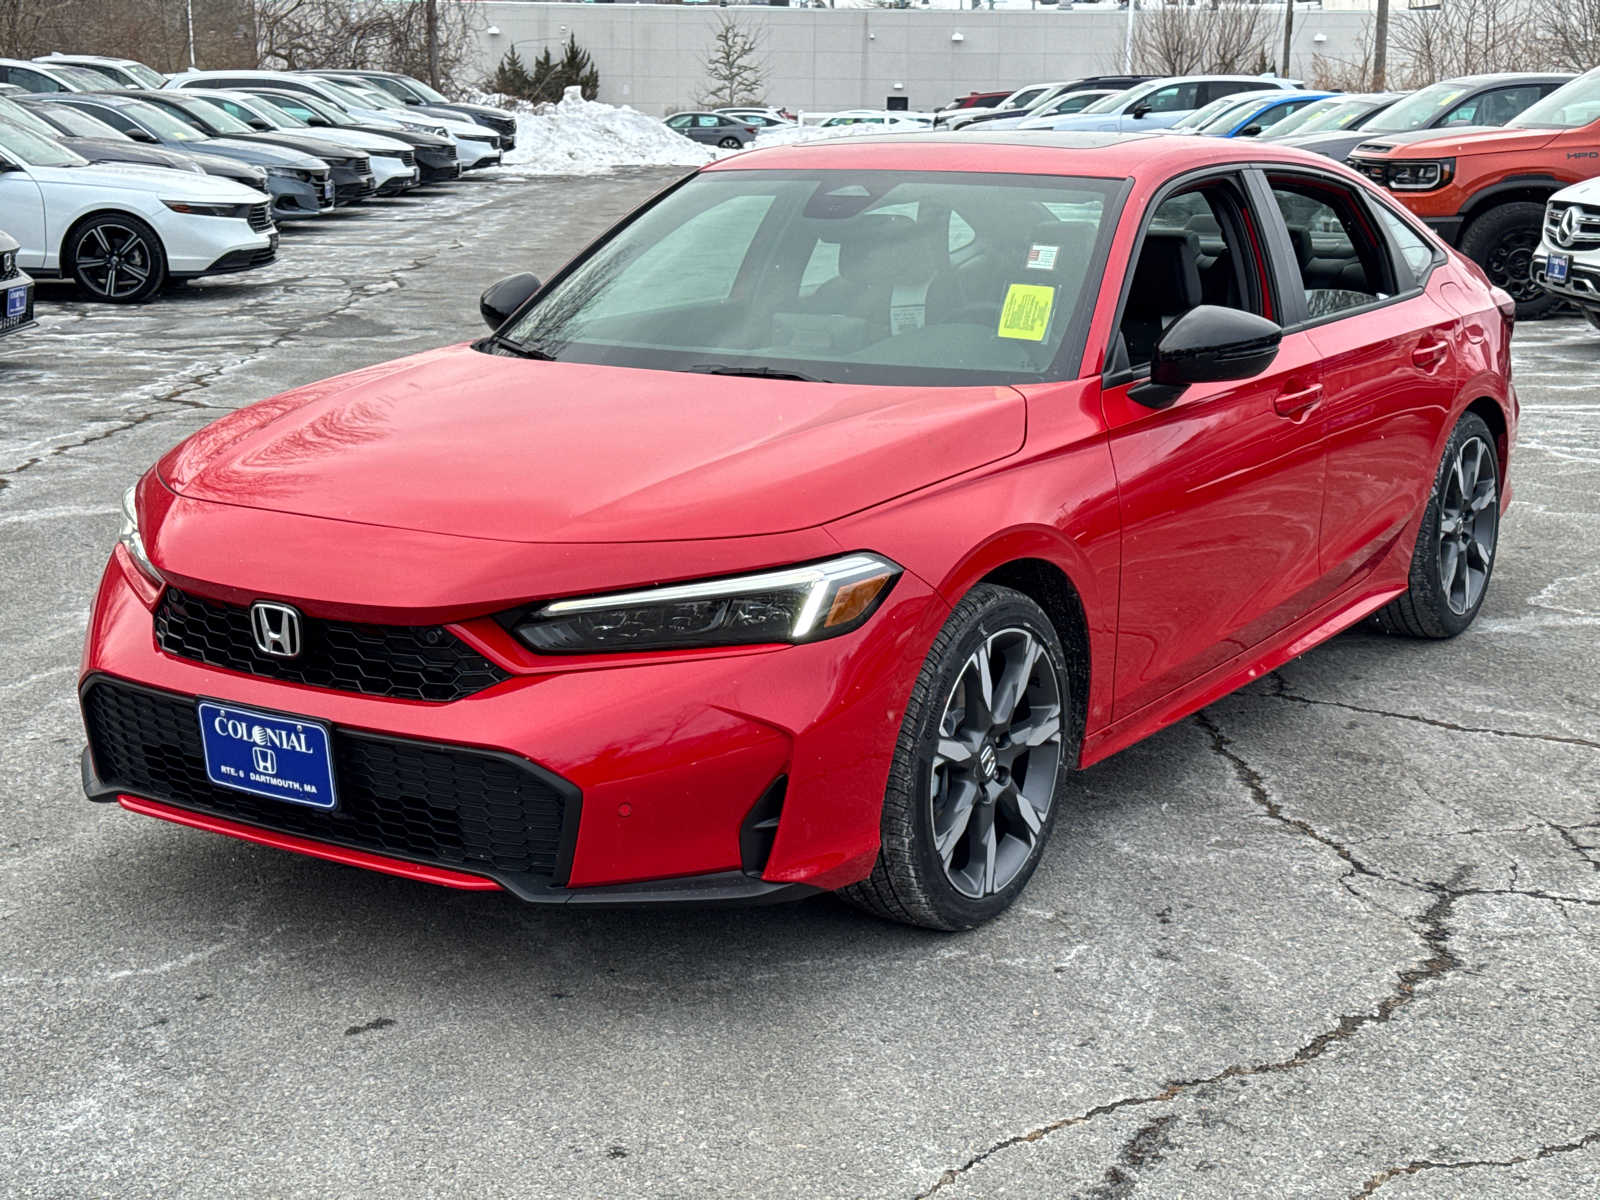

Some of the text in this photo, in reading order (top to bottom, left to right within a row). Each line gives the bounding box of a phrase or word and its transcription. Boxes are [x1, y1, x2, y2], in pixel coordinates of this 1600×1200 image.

[1567, 151, 1599, 159] HPD
[214, 716, 313, 754] COLONIAL
[304, 784, 318, 793] MA
